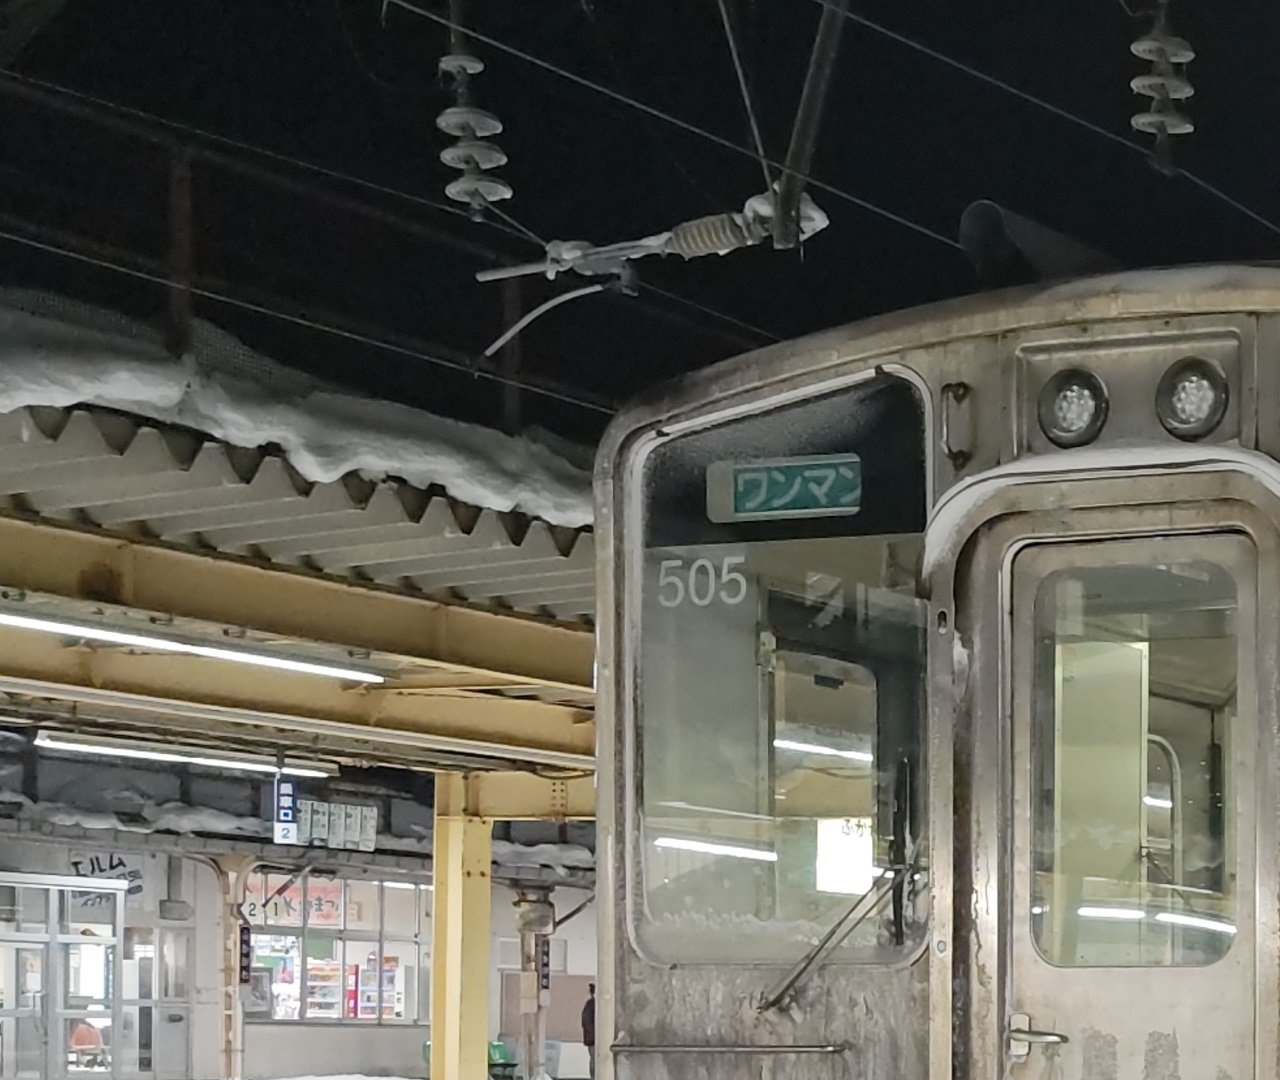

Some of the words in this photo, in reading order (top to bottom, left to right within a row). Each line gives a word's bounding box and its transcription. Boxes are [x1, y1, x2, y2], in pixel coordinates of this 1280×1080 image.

[737, 463, 861, 509] ワンマン
[659, 556, 747, 607] 505
[281, 828, 290, 839] 2
[248, 902, 257, 917] 2
[273, 902, 279, 916] 1
